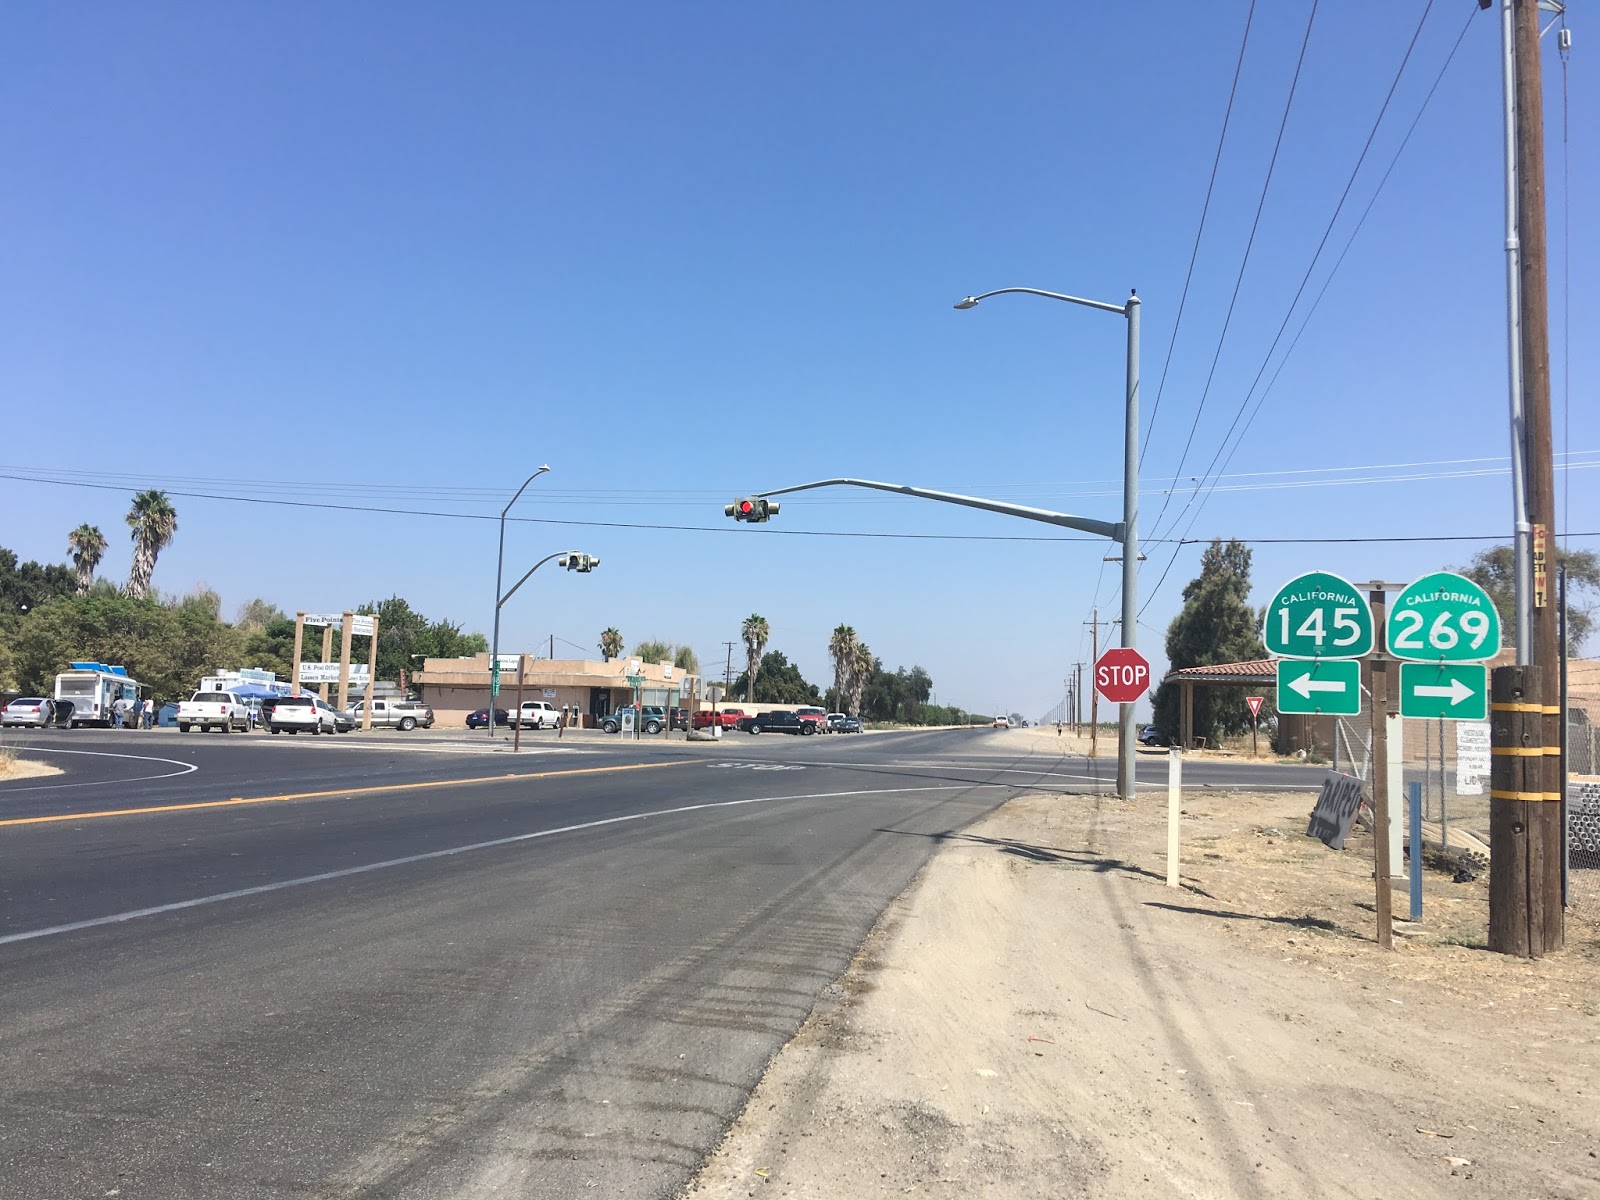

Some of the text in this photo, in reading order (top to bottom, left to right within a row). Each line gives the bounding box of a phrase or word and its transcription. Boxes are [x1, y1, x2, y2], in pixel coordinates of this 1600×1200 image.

[1281, 591, 1356, 606] CALIFORNIA
[1406, 592, 1481, 607] CALIFORNIA
[1278, 607, 1361, 646] 145
[1394, 609, 1490, 650] 269
[1098, 665, 1147, 687] STOP
